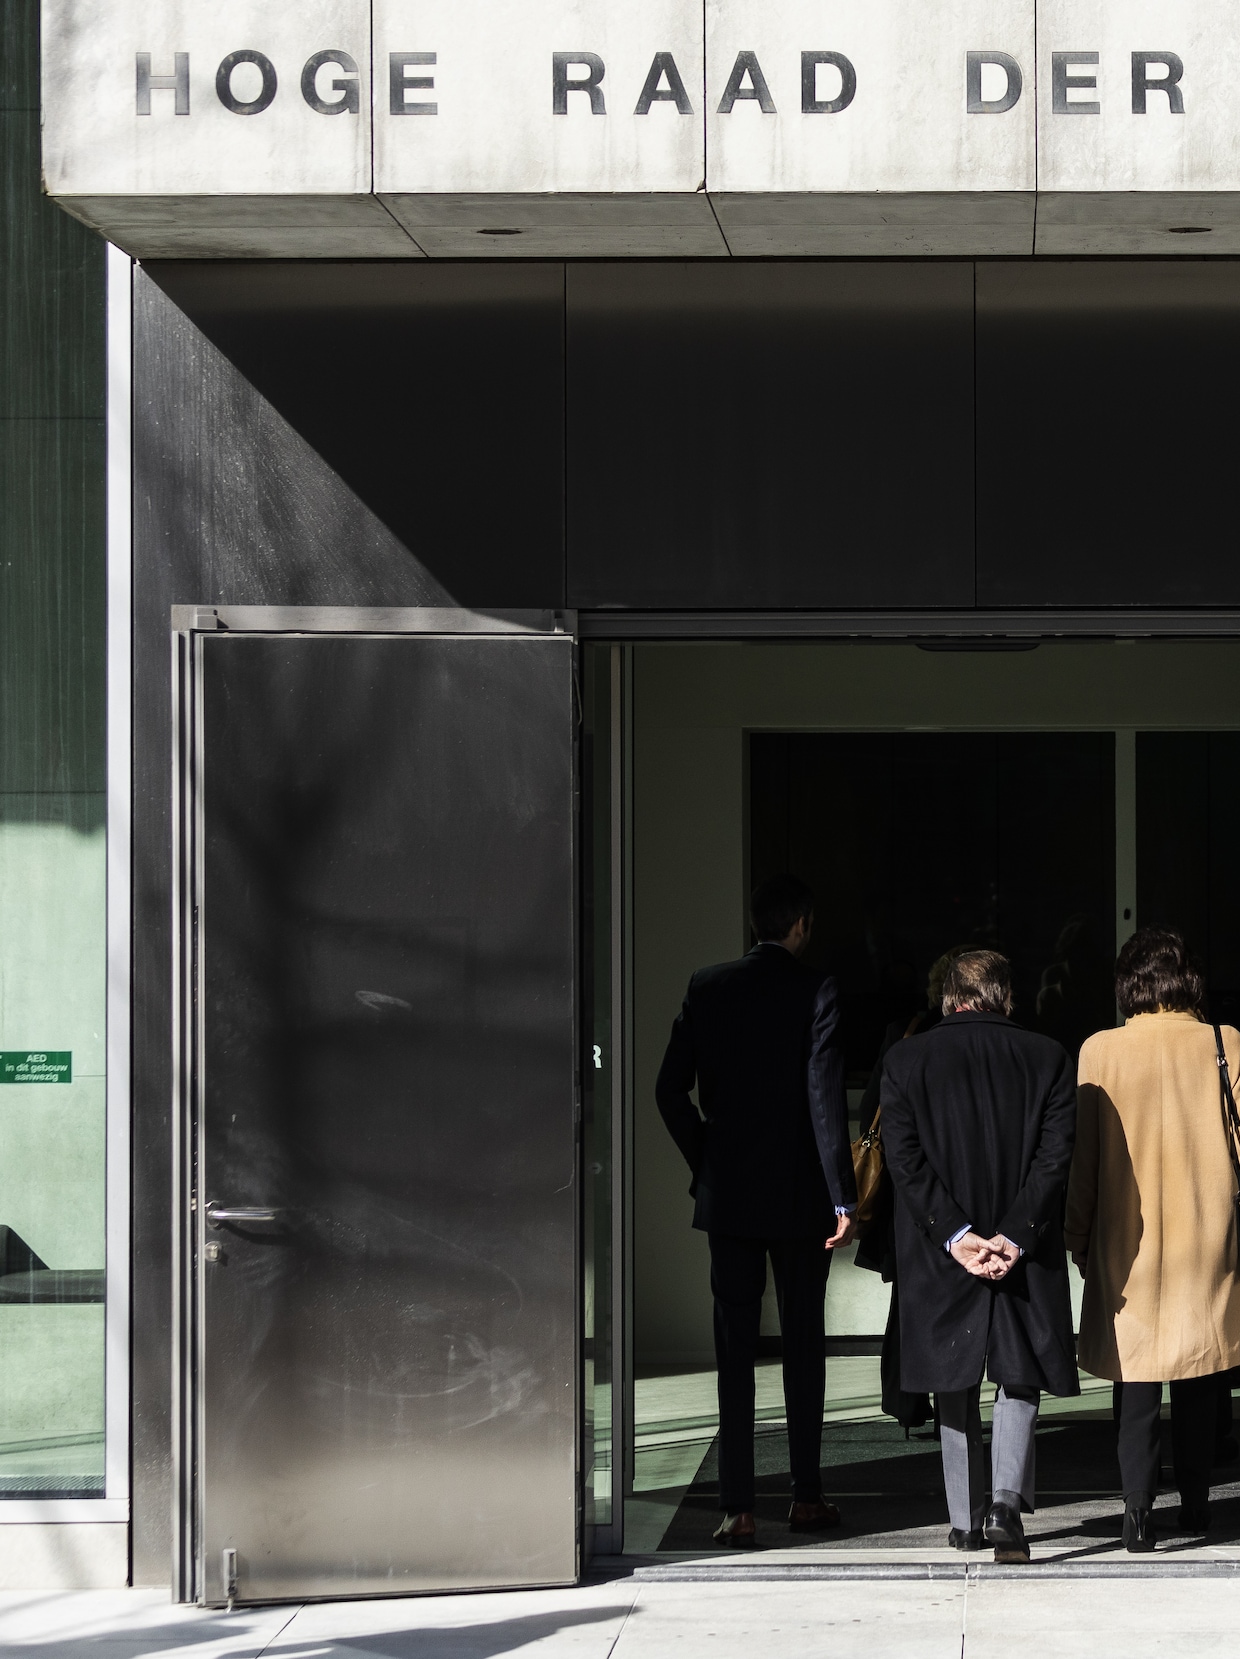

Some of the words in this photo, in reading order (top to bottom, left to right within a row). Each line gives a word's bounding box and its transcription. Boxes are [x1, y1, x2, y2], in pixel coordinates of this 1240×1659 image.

[136, 49, 439, 116] HOGE
[551, 50, 858, 116] RAAD
[965, 50, 1186, 115] DER
[26, 1054, 47, 1063] AED
[5, 1063, 15, 1072] in
[16, 1063, 29, 1072] dit
[30, 1063, 68, 1074] gebouw
[15, 1072, 58, 1082] aanwezig
